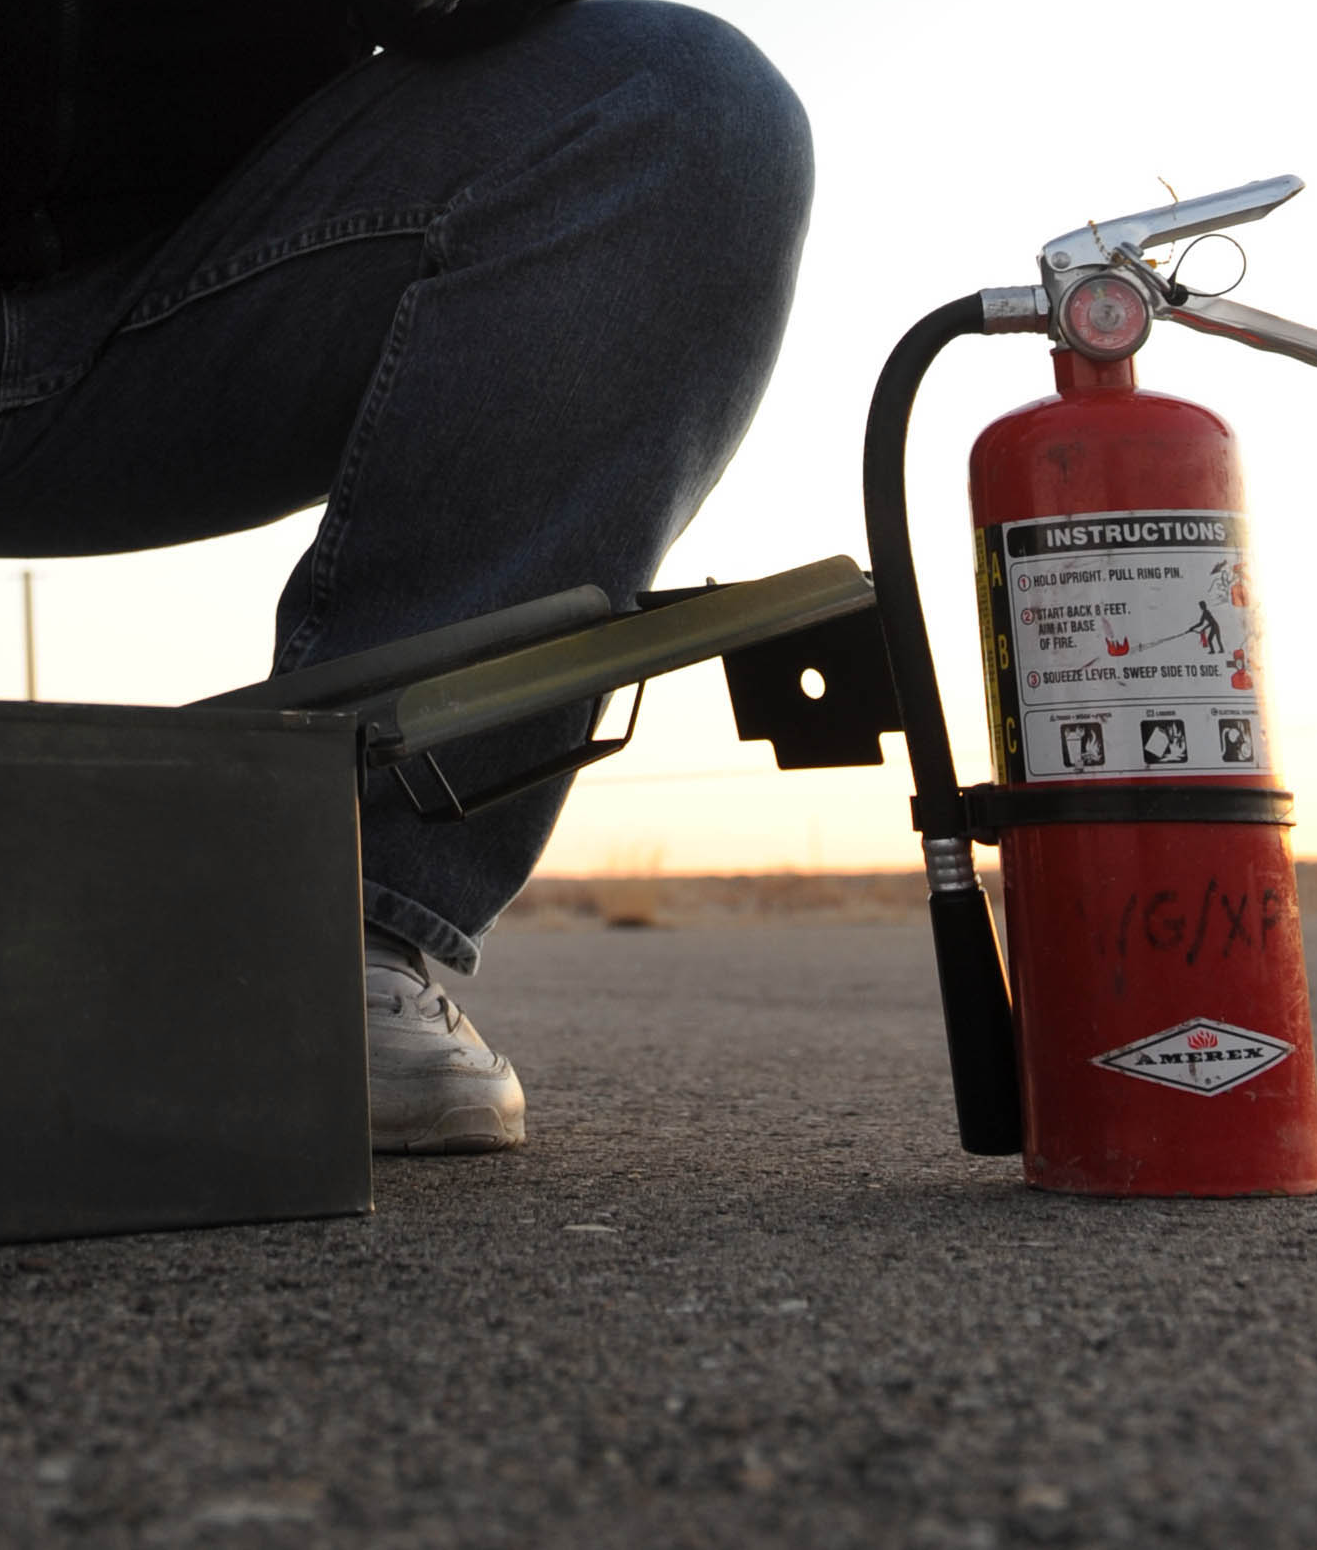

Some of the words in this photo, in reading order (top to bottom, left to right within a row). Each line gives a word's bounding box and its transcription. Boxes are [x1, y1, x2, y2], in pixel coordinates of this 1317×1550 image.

[1046, 521, 1226, 548] INSTRUCTIONS
[991, 551, 1003, 587] A
[1033, 574, 1057, 587] HOLD
[1108, 568, 1134, 581] PULL
[1137, 567, 1162, 580] RING
[1164, 567, 1184, 579] PIN.
[1037, 606, 1064, 620] START
[1067, 604, 1092, 618] BACK
[1104, 603, 1131, 616] FEET.
[1038, 623, 1055, 635] AIM
[1057, 622, 1068, 634] AT
[1070, 620, 1096, 633] BASE
[998, 633, 1010, 669] B
[1039, 638, 1051, 650] OF
[1053, 636, 1077, 649] FIRE.
[1043, 669, 1083, 685] SQUEEZE
[1085, 668, 1120, 682] LEVER.
[1123, 666, 1157, 679] SWEEP
[1161, 665, 1183, 678] SIDE
[1185, 665, 1197, 677] TO
[1200, 664, 1222, 677] SIDE.
[1005, 716, 1017, 754] C
[1135, 1047, 1265, 1066] AMEREX
